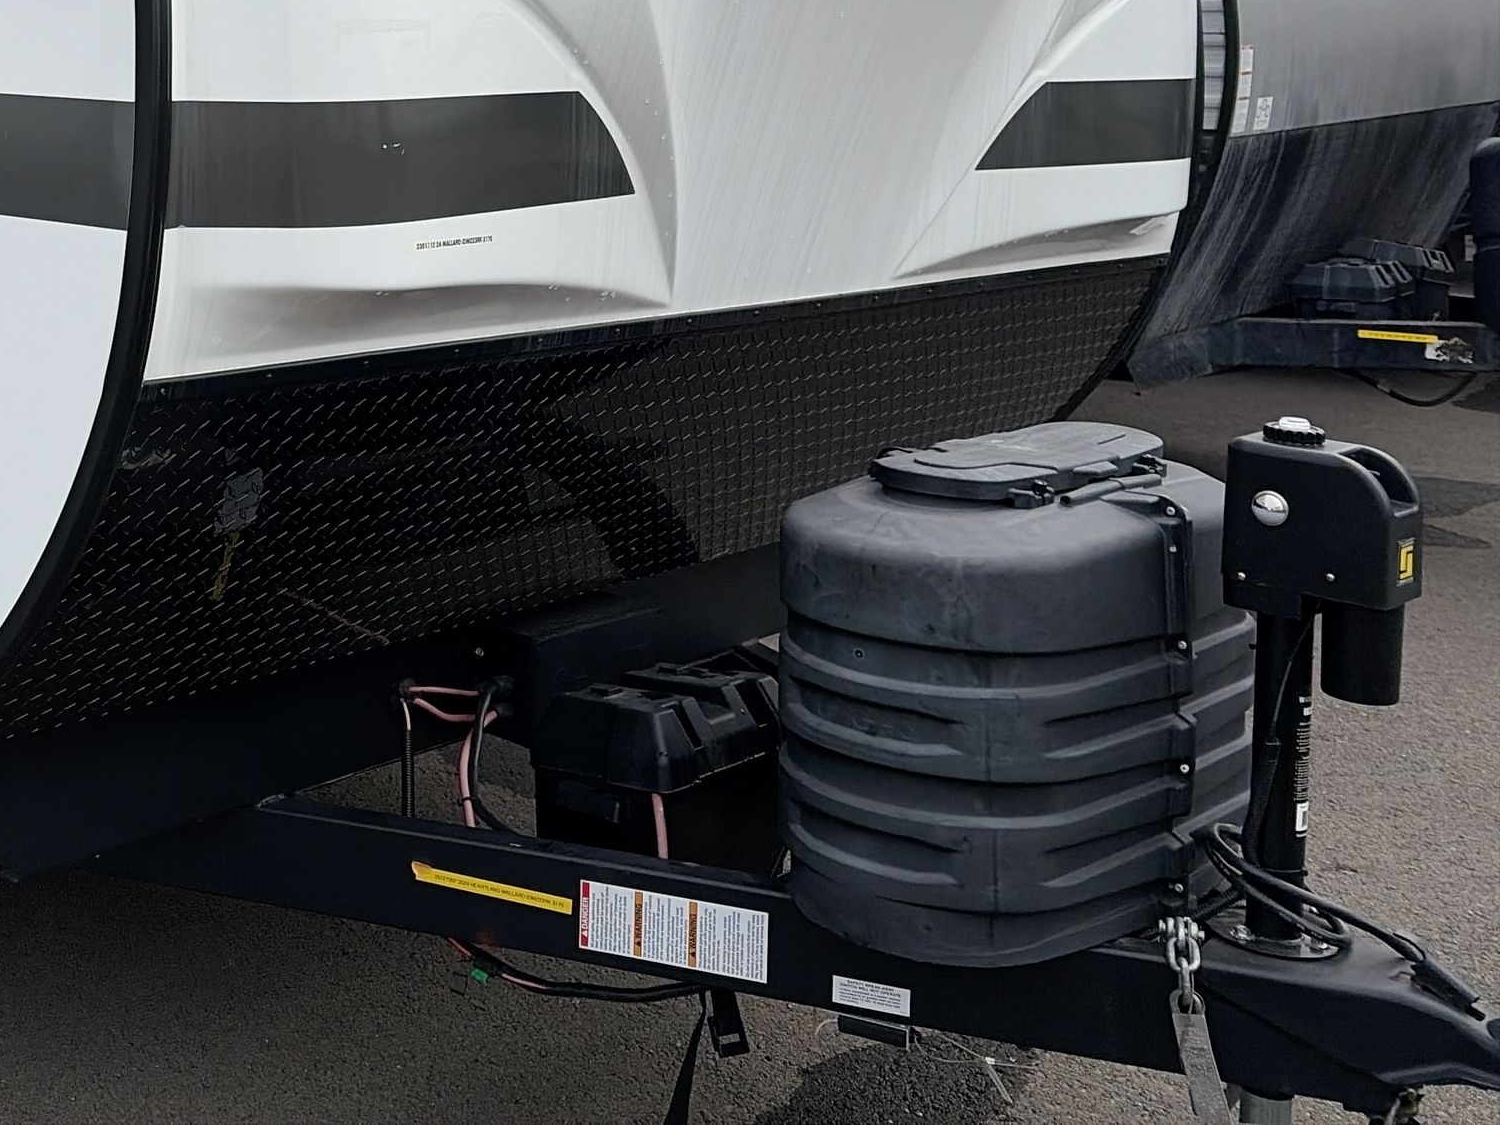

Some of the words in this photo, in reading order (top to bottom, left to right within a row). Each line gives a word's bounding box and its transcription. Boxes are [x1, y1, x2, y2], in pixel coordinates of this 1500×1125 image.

[442, 239, 461, 247] MALLARD
[470, 881, 501, 894] HEARTLAND
[501, 888, 526, 899] MALLARD
[634, 903, 643, 941] WARNING
[689, 913, 698, 950] WARNING
